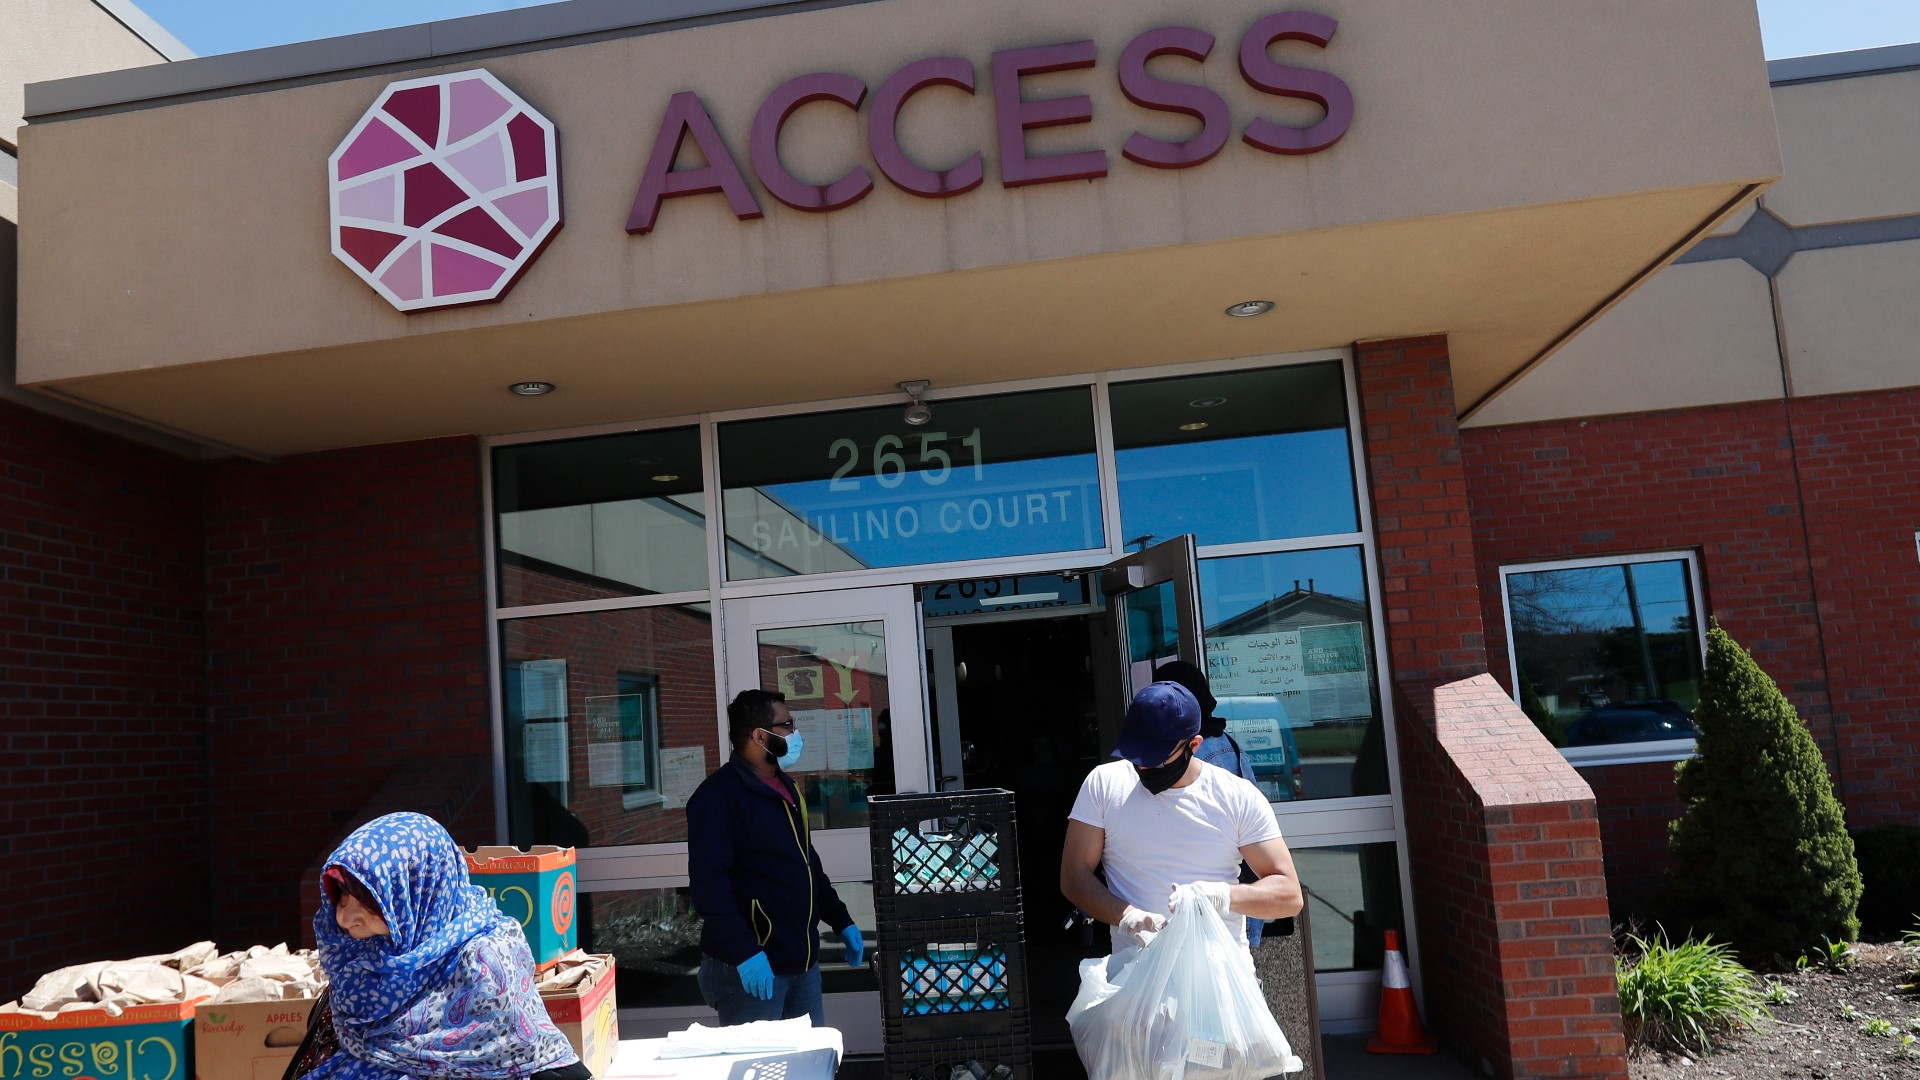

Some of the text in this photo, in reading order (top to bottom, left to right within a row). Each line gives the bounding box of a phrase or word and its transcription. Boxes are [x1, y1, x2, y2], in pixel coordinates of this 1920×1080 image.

[625, 10, 1354, 236] ACCESS
[827, 427, 984, 492] 2651
[752, 490, 1072, 551] SAULINO COURT
[202, 1020, 246, 1036] Riveridge
[266, 1012, 303, 1024] APPLES
[0, 1031, 178, 1080] Classy
